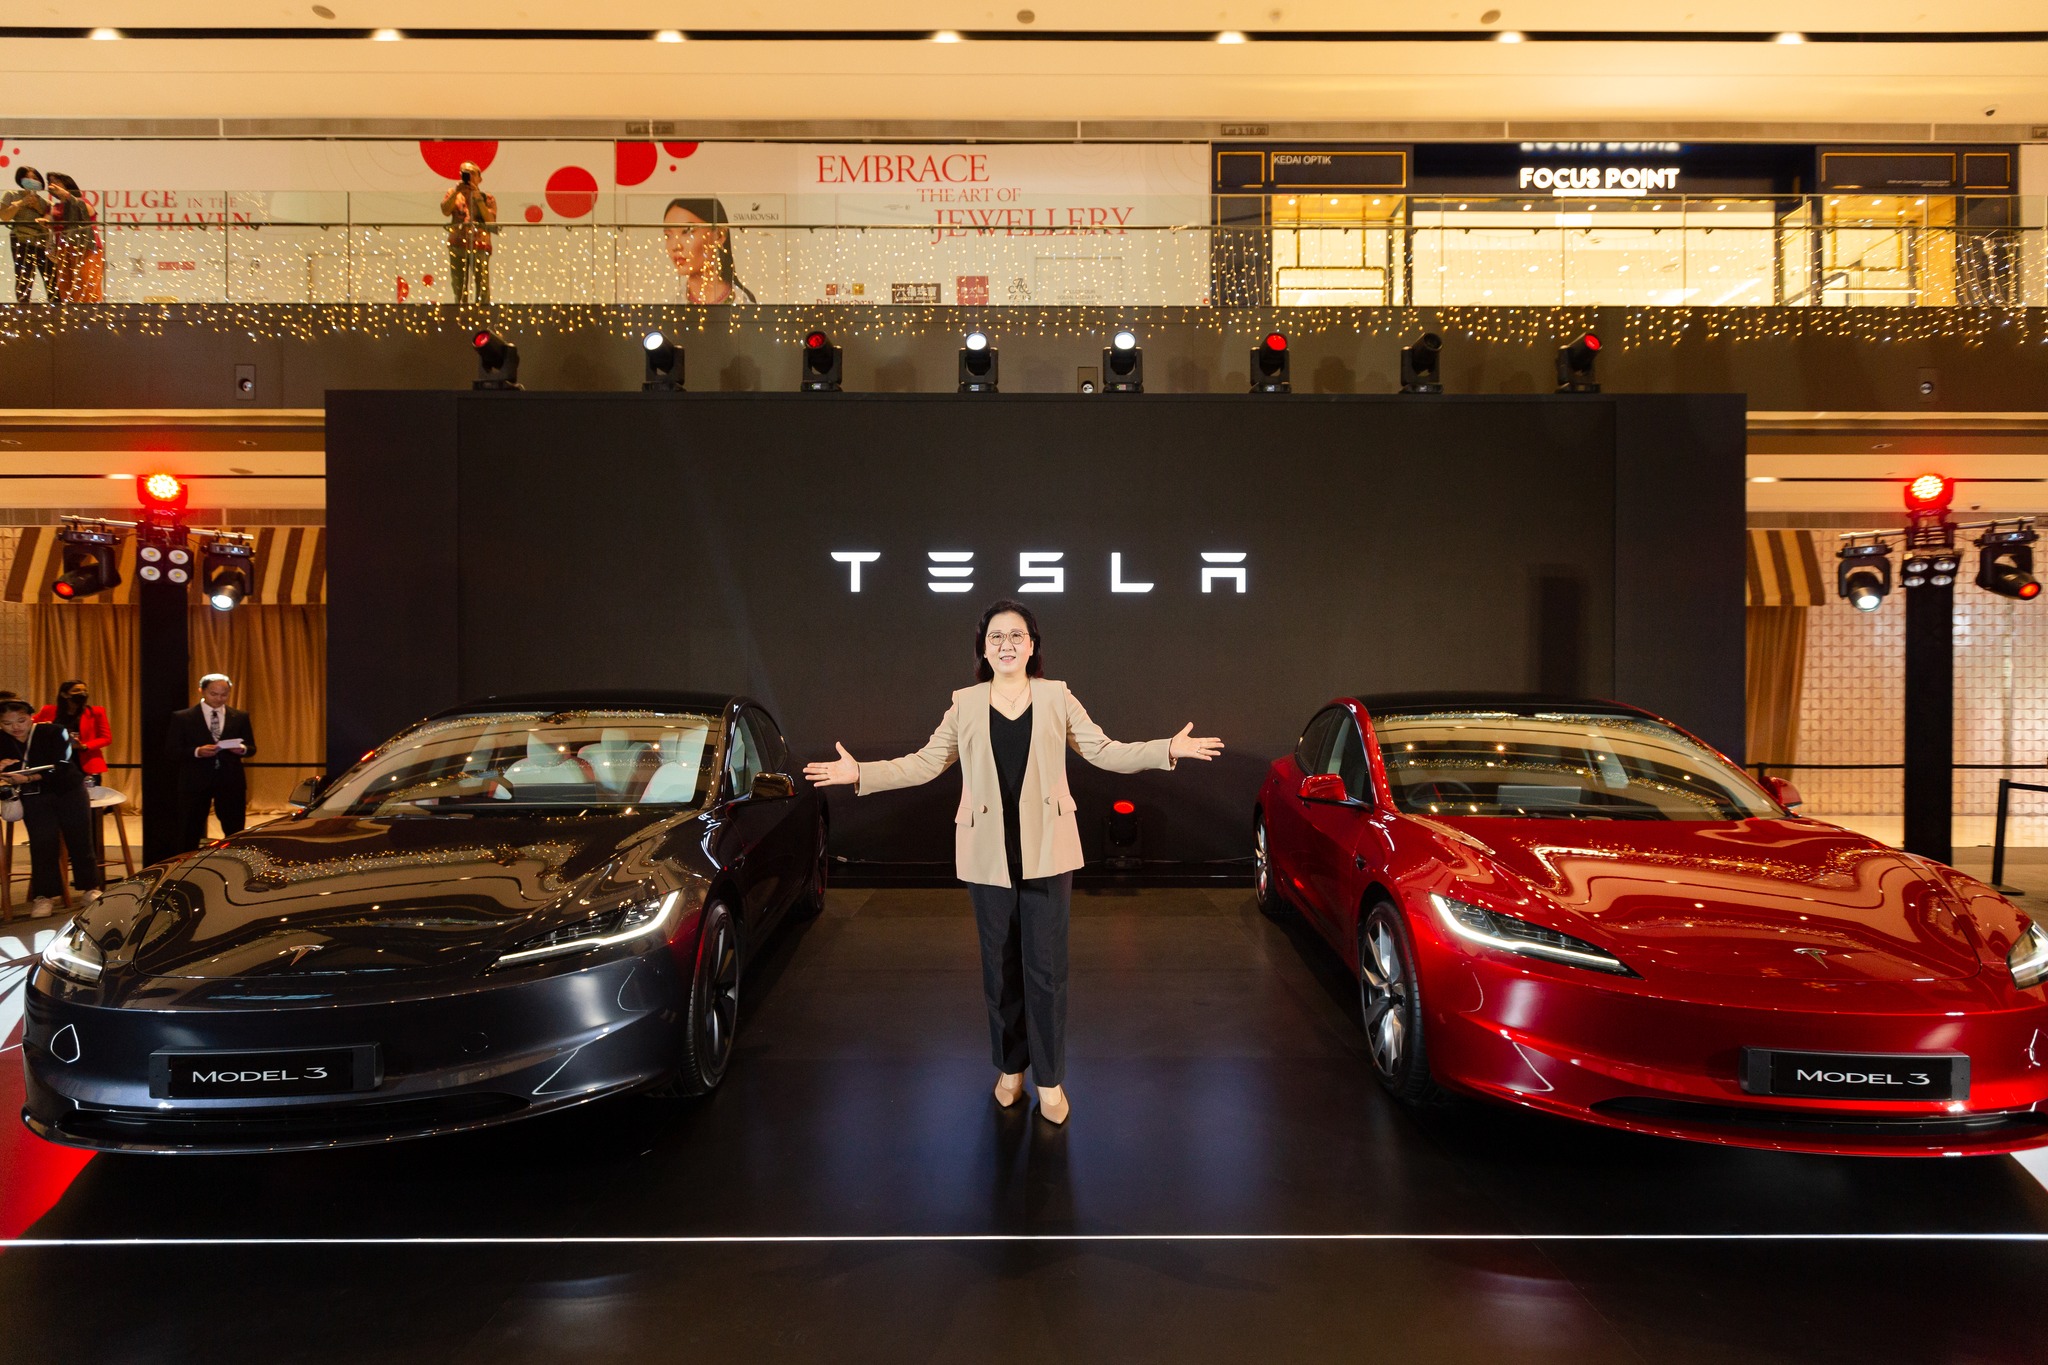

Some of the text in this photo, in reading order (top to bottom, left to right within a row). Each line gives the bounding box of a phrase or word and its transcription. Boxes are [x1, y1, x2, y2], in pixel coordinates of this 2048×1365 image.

[816, 154, 990, 183] EMBRACE
[1274, 156, 1332, 165] KEDAI OPTIK
[1519, 167, 1681, 189] FOCUS POINT
[48, 190, 178, 209] DULGE
[187, 198, 203, 208] IN
[916, 187, 1022, 203] THE ART OF
[155, 212, 252, 231] HAVEN
[733, 213, 779, 221] SWAROVSKI
[931, 206, 1135, 245] JEWELLERY
[830, 551, 1248, 594] TESLA
[192, 1066, 328, 1083] MODEL 3
[1796, 1069, 1931, 1086] MODEL 3
